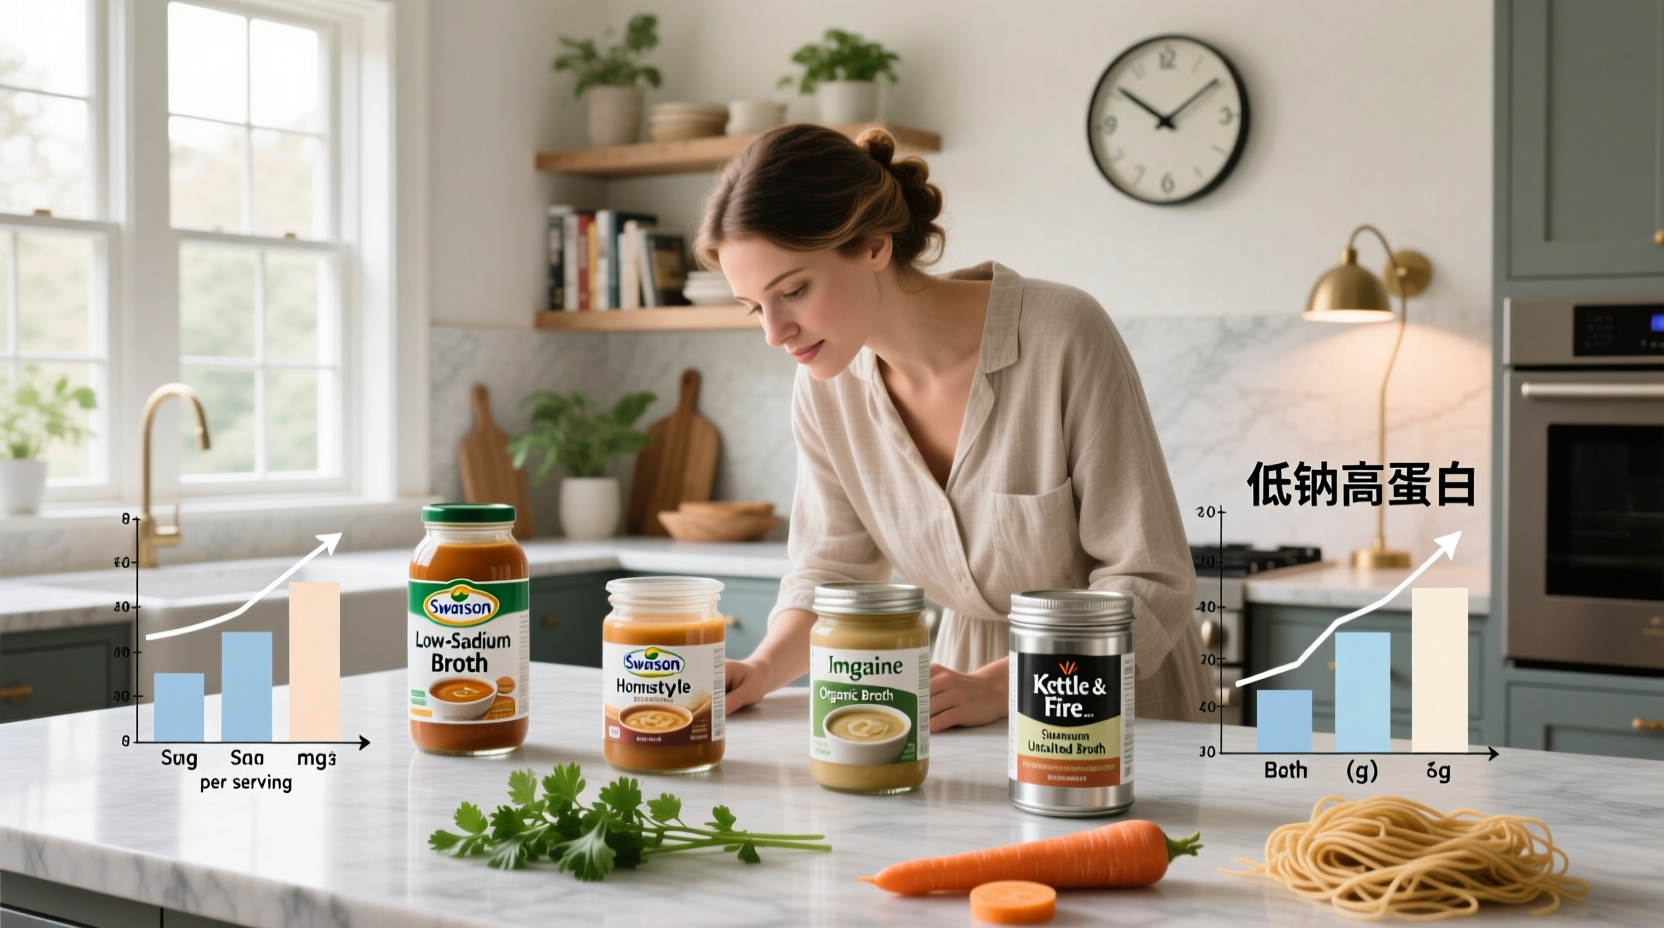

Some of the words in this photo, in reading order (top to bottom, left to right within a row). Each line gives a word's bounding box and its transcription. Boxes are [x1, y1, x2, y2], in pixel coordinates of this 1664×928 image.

[431, 651, 488, 673] Broth
[1092, 677, 1107, 696] &
[1044, 695, 1083, 718] Fire
